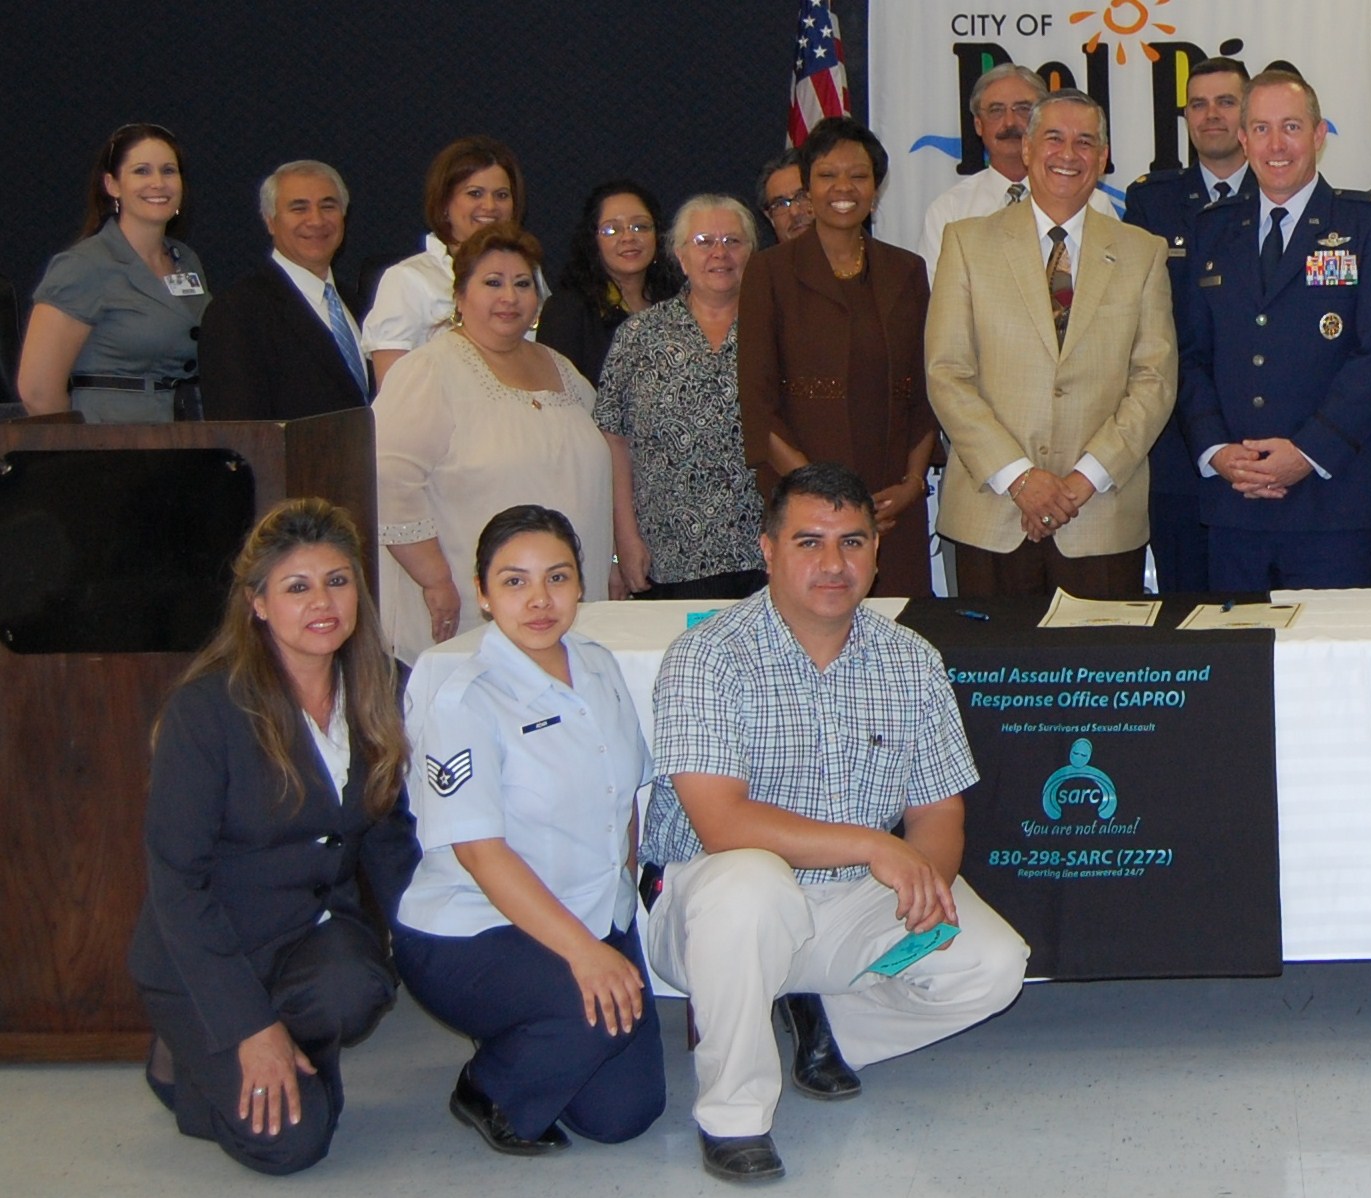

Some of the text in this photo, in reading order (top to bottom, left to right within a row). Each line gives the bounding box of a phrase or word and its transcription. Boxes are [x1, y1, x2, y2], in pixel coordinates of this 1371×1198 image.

[951, 14, 1053, 36] CITY OF
[947, 665, 1211, 684] Sexual Assault Prevention and
[970, 690, 1186, 711] Response Office (SAPRO)
[1001, 722, 1156, 734] Help for Survivors of Sexual Assault
[1058, 788, 1099, 804] sarc
[1021, 816, 1141, 837] You are not alone!
[989, 849, 1173, 866] 830-298-SARC (7272)
[1017, 868, 1061, 879] Reporting
[1062, 869, 1079, 878] line
[1124, 867, 1146, 877] 24/7
